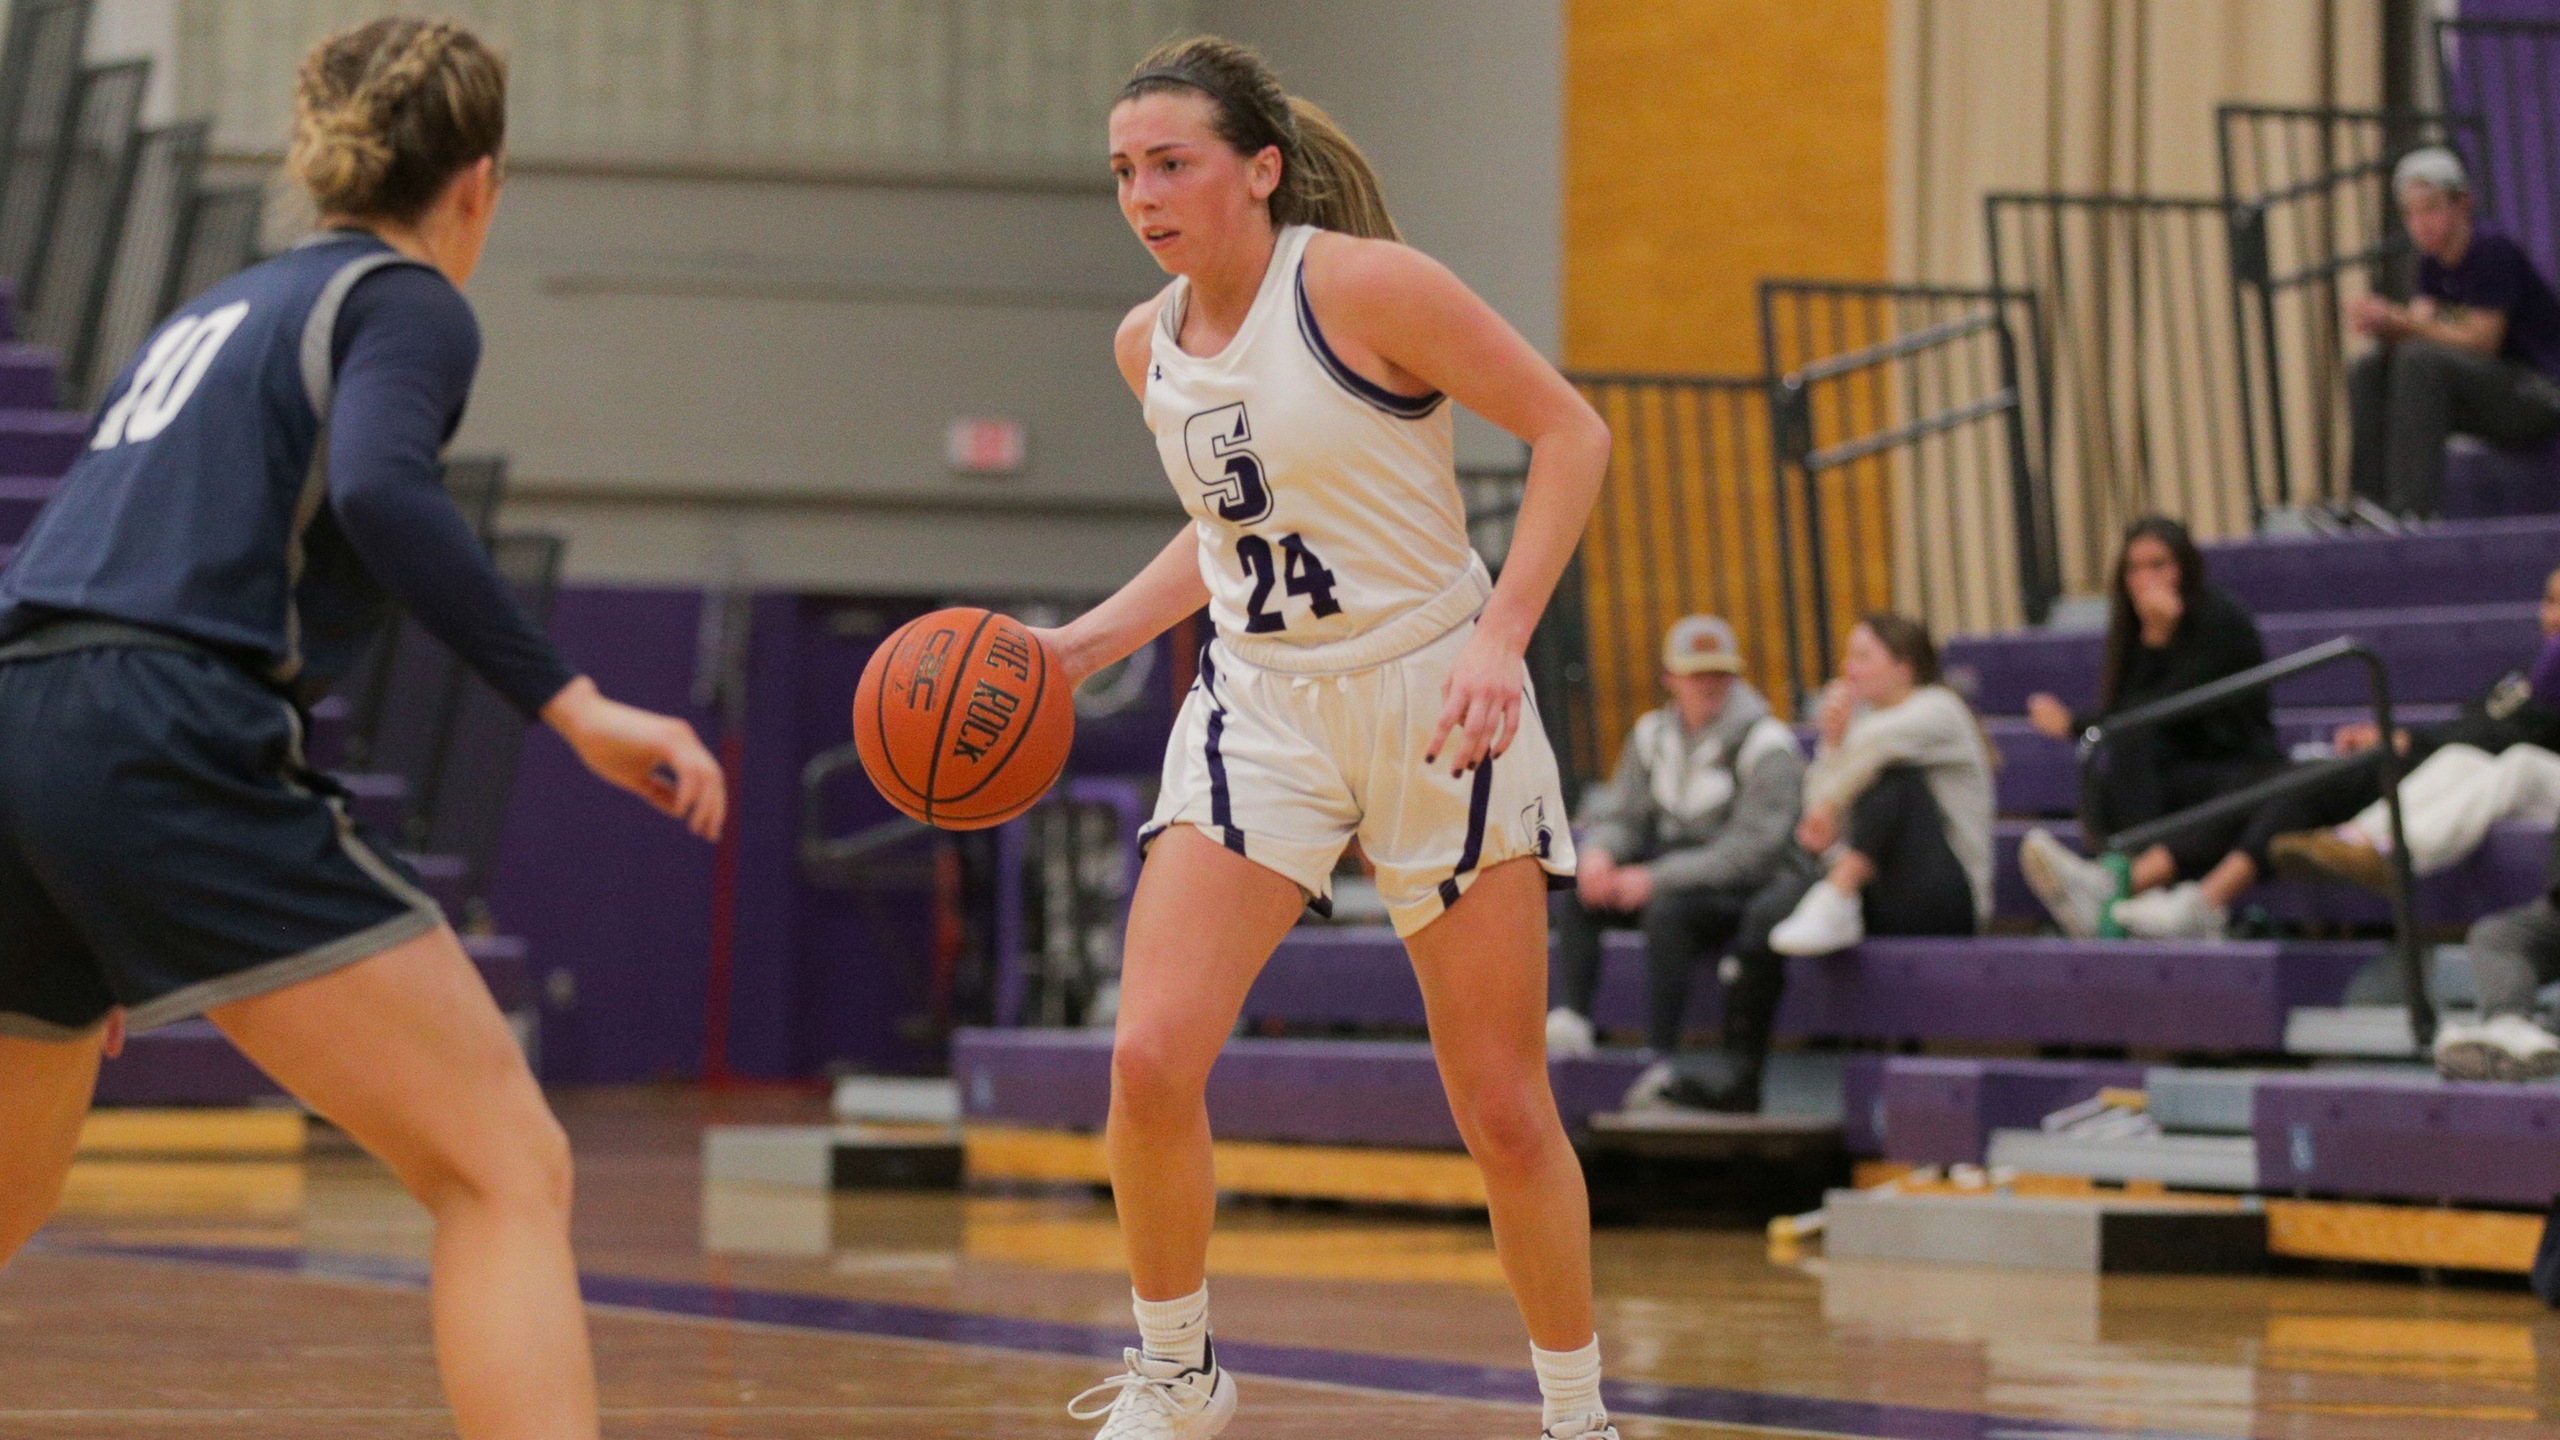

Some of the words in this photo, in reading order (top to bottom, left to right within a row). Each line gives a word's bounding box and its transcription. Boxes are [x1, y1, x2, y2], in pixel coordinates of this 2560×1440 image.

[90, 299, 250, 451] 10
[1184, 401, 1273, 526] S
[1236, 532, 1342, 633] 24
[986, 626, 1029, 682] THE
[953, 679, 1021, 763] ROCK
